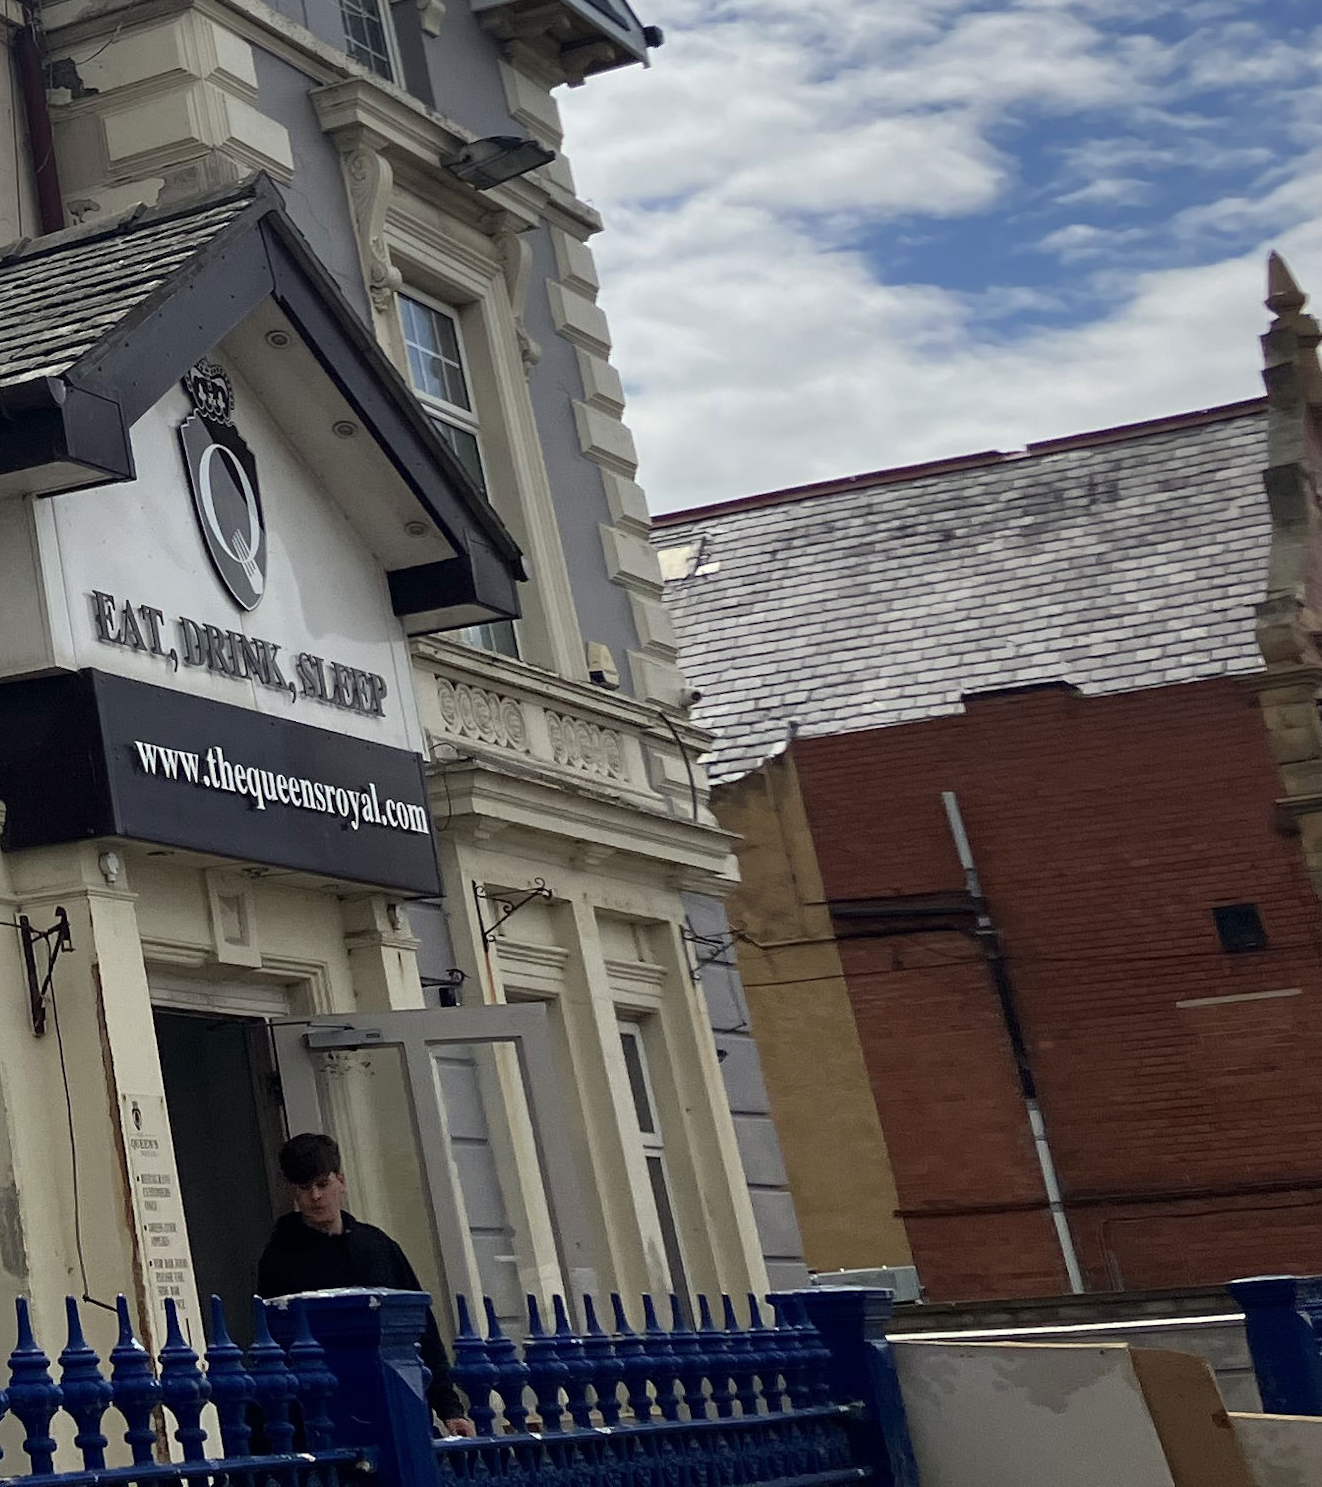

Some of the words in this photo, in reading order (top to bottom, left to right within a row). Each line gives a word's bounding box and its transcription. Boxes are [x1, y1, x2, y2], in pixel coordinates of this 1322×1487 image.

[198, 442, 265, 596] Q
[91, 589, 179, 673] EAT,
[178, 616, 297, 703] DRINK,
[296, 652, 388, 718] SLEEP
[134, 739, 430, 836] www.thequeensroyal.com
